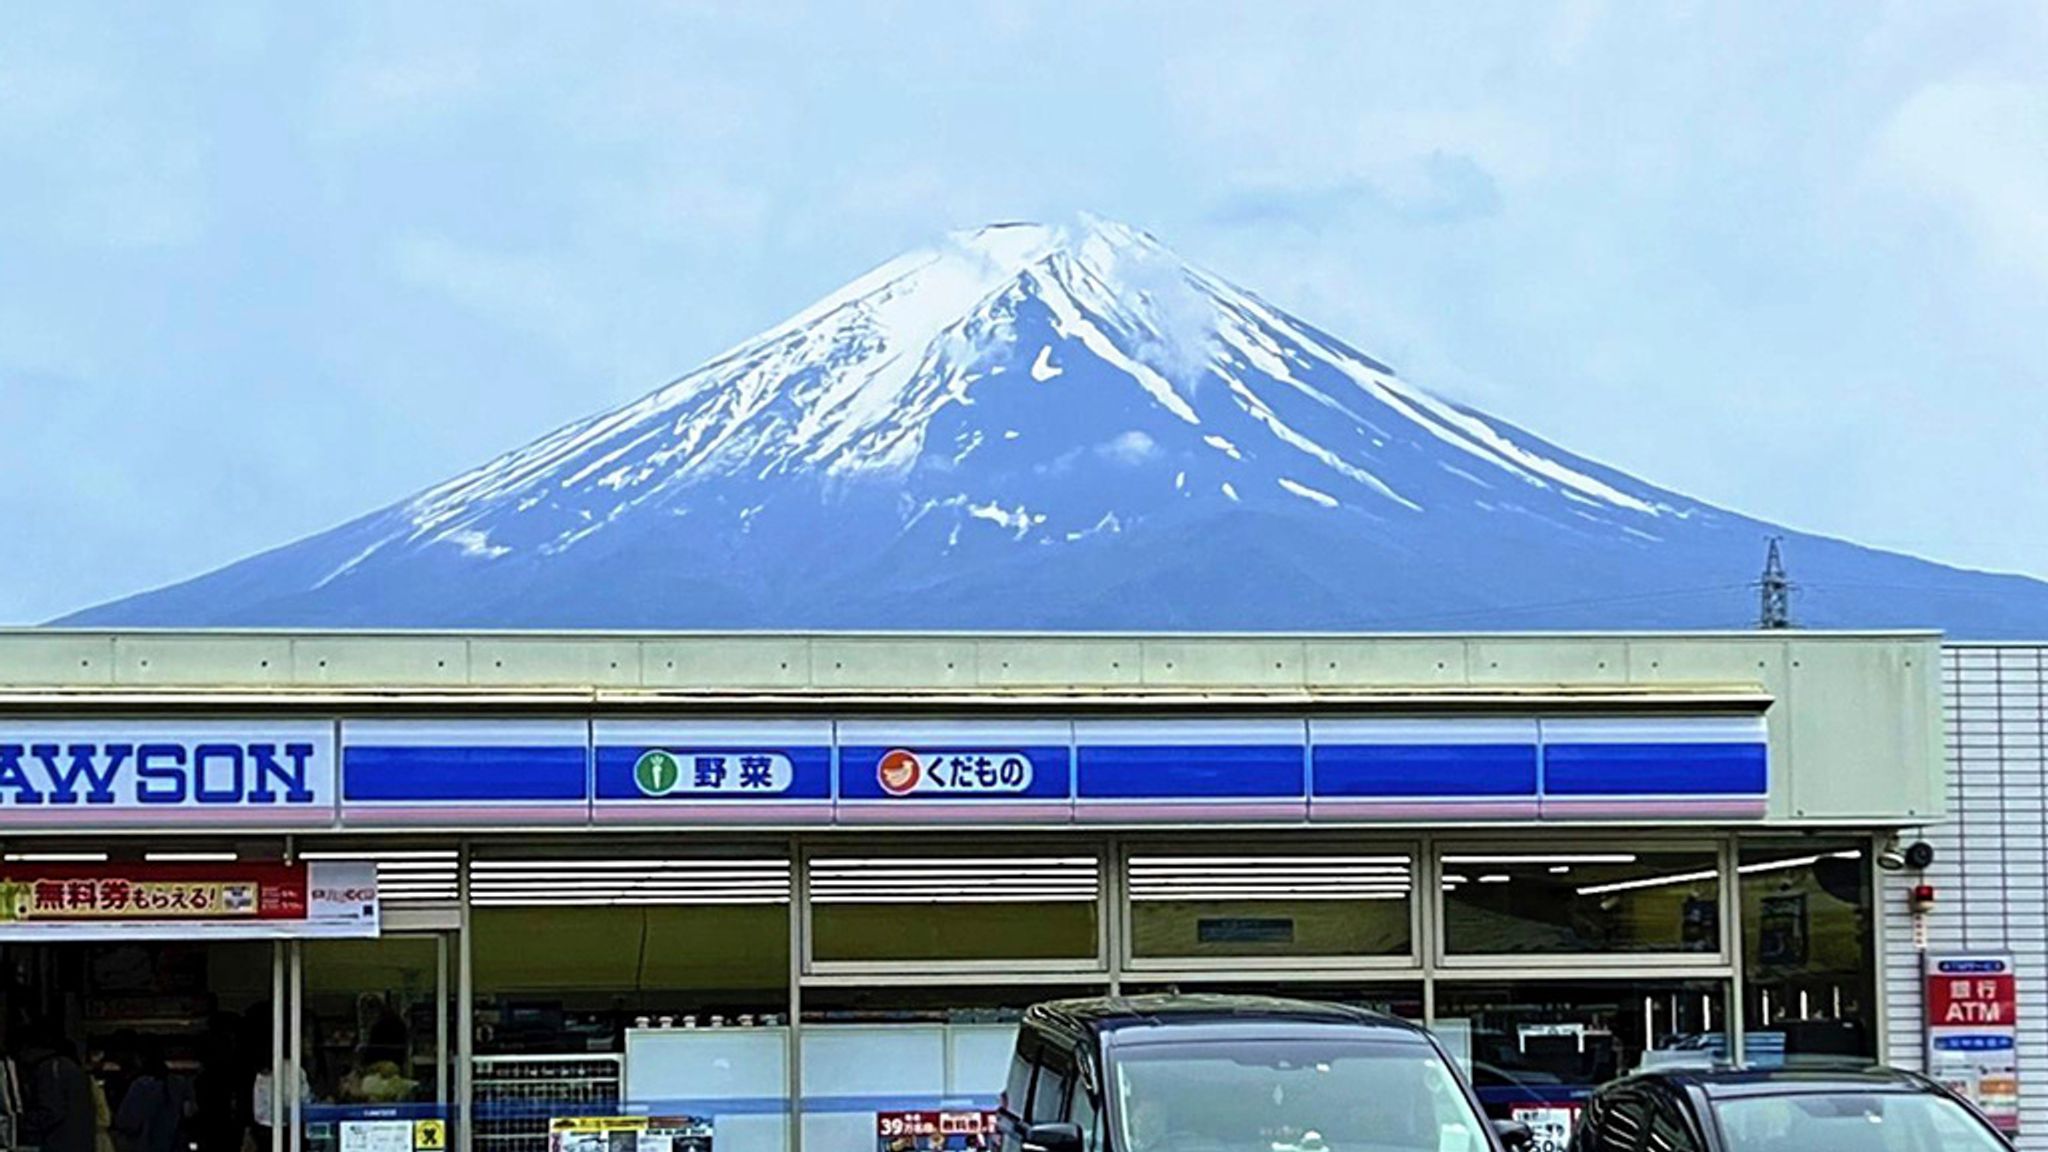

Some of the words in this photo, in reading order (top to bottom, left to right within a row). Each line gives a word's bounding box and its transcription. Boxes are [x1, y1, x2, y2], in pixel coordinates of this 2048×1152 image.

[694, 756, 773, 788] 野菜
[927, 754, 1023, 788] くだもの
[1945, 1002, 2000, 1022] ATM
